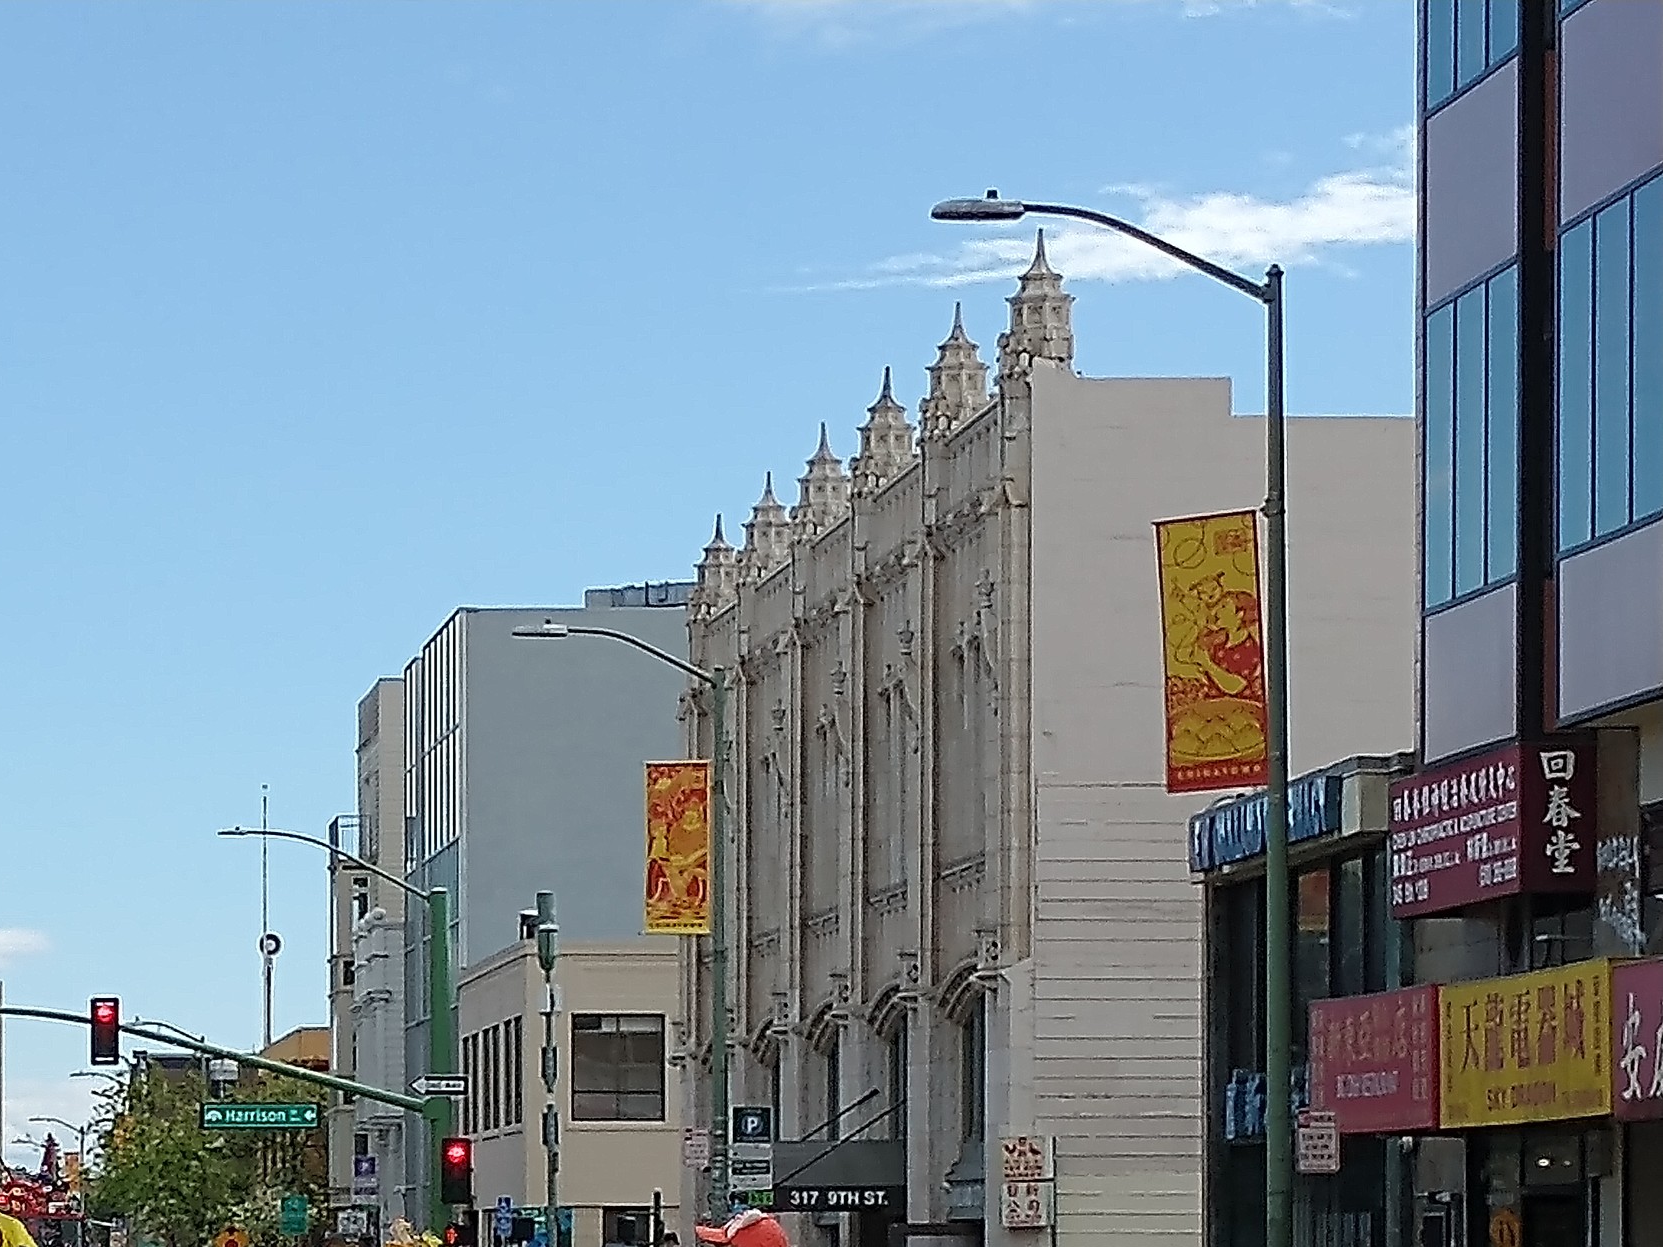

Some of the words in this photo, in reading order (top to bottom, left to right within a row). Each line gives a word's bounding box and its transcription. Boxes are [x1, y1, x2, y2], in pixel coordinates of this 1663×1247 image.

[1540, 750, 1581, 873] 回春堂
[225, 1110, 285, 1123] Harrison
[747, 1117, 759, 1133] P
[790, 1190, 820, 1205] 317
[827, 1190, 860, 1205] 9TH
[863, 1190, 889, 1206] ST.
